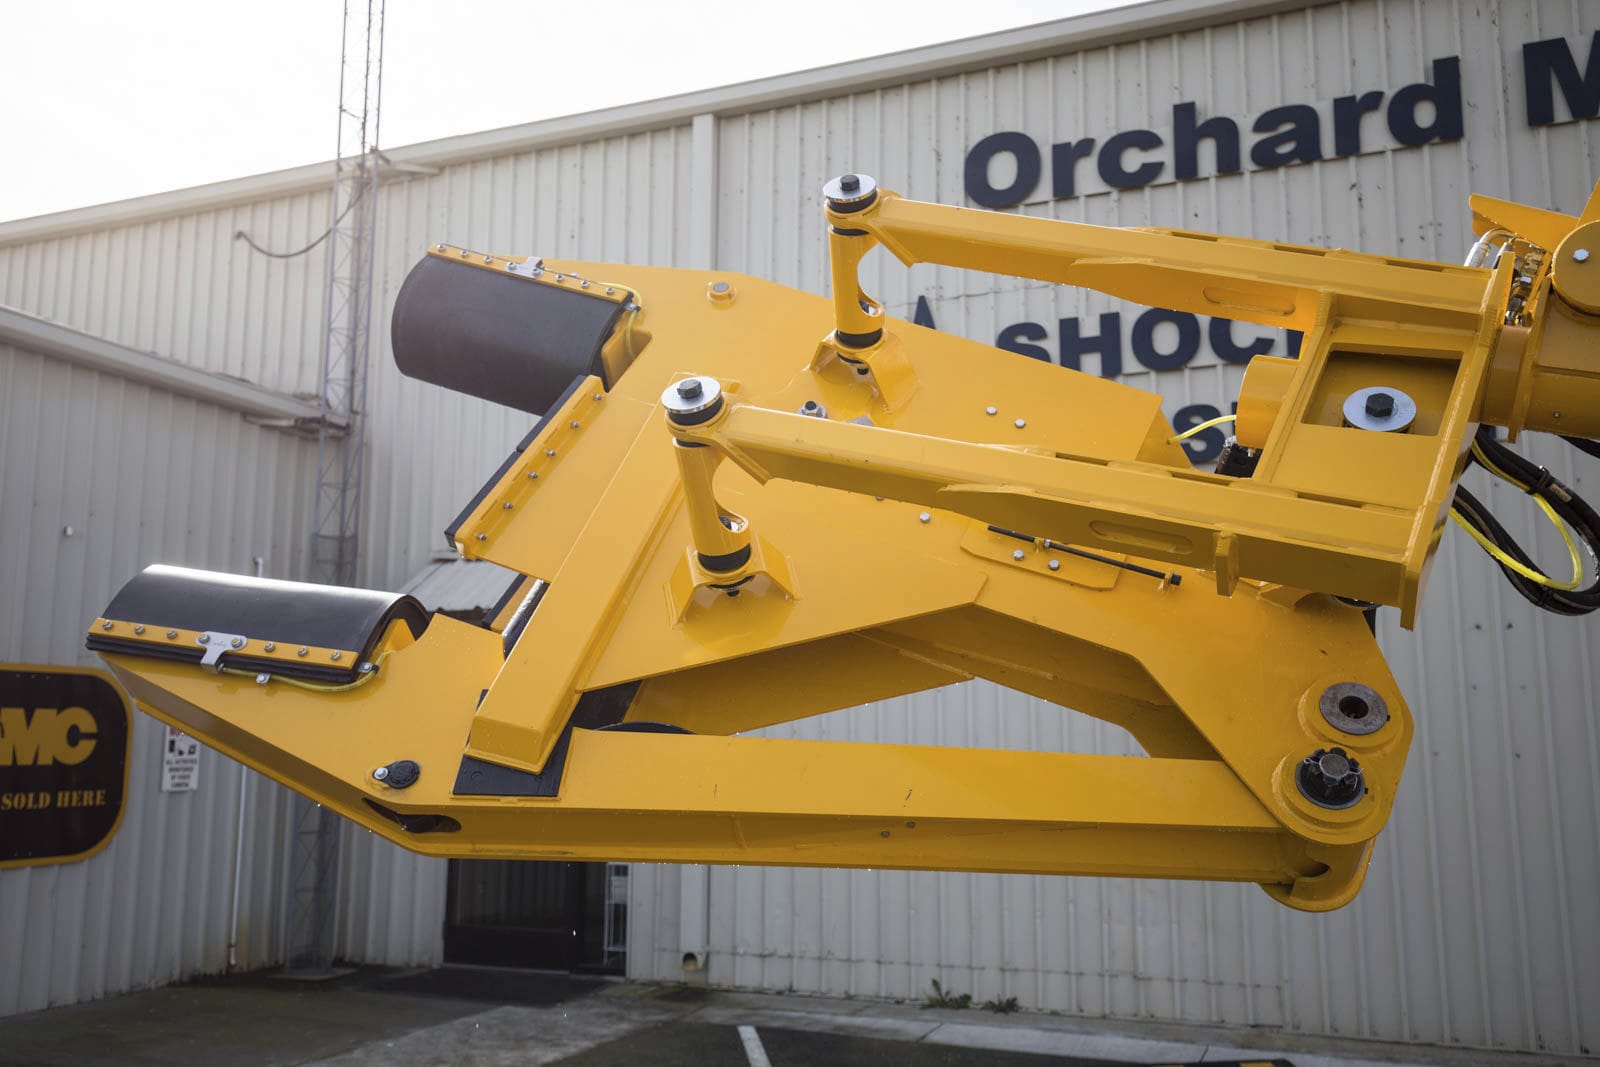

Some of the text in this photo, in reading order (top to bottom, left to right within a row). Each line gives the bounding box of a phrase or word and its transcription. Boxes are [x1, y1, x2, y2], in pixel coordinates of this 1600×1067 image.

[964, 55, 1464, 209] Orchard
[996, 307, 1304, 377] SHOC
[0, 707, 98, 766] MC
[0, 789, 107, 811] SOLD HERE
